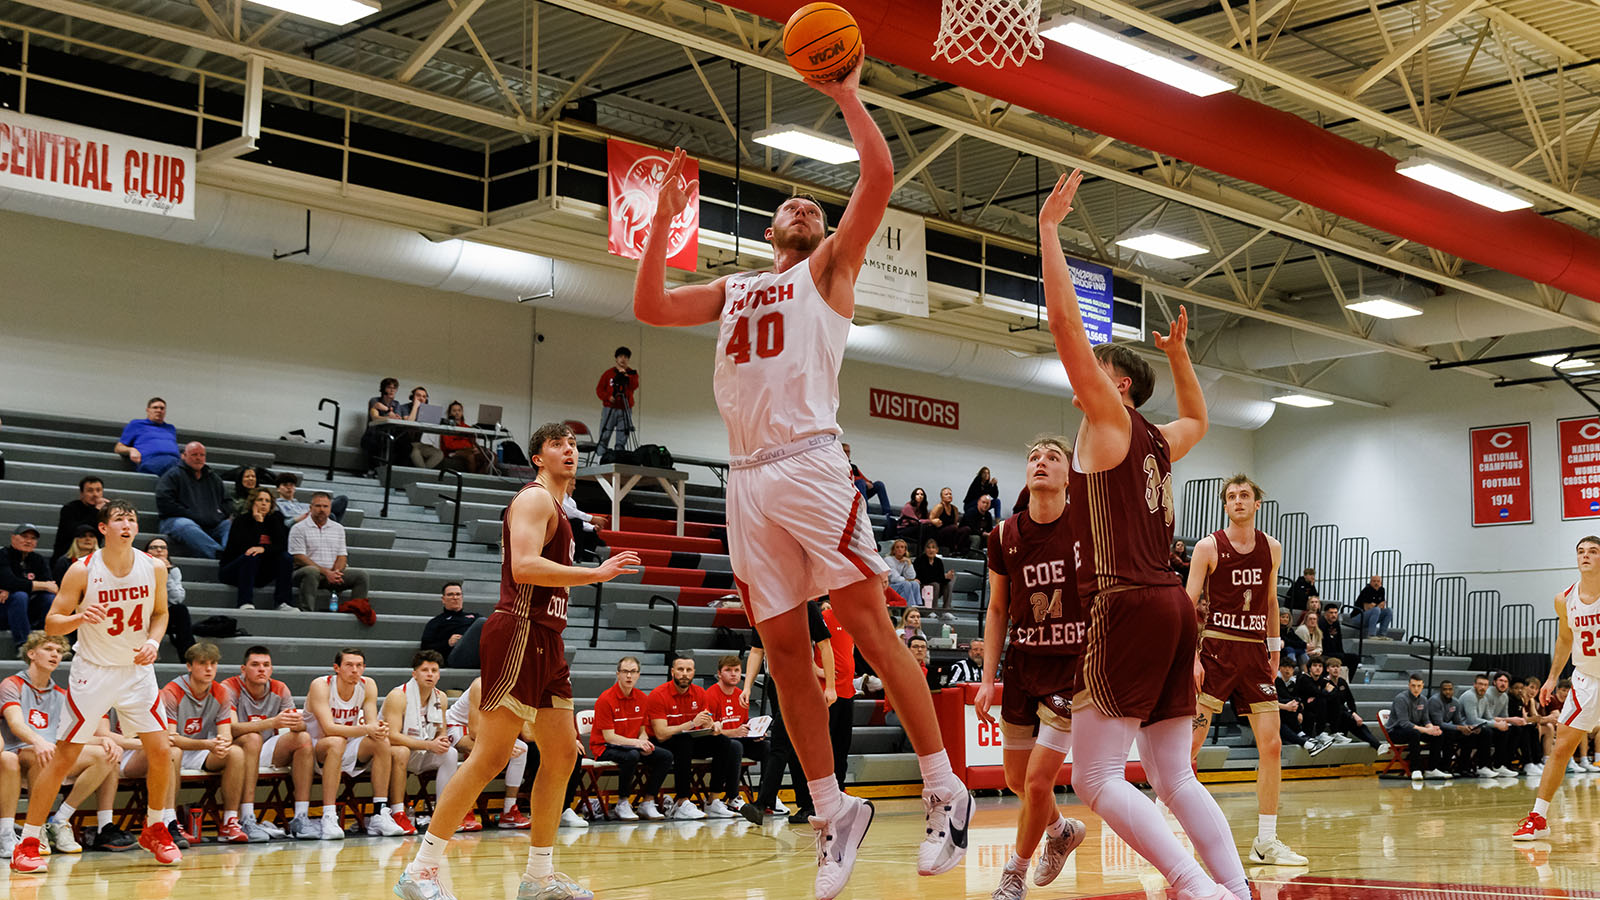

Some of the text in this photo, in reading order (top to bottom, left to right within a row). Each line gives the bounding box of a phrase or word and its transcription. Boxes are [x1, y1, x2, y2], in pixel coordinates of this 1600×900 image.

[808, 40, 845, 65] NCAA
[0, 122, 185, 205] CENTRAL CLUB
[863, 258, 918, 278] AMSTERDAM
[726, 311, 784, 364] 40
[873, 392, 956, 425] VISITORS
[1483, 451, 1518, 462] NATIONAL
[1571, 443, 1600, 454] NATION
[1479, 460, 1523, 472] CHAMPIONS
[1567, 452, 1600, 464] CHAMPI
[1482, 477, 1521, 488] FOOTBALL
[1563, 475, 1587, 486] CROSS
[1491, 494, 1513, 506] 1974
[1580, 487, 1600, 499] 198
[1023, 560, 1065, 588] COE
[1232, 568, 1262, 585] COE
[98, 585, 149, 603] DUTCH
[1242, 589, 1252, 611] 1
[1029, 589, 1063, 623] 24
[106, 604, 143, 636] 34
[1213, 612, 1267, 630] COLLEGE
